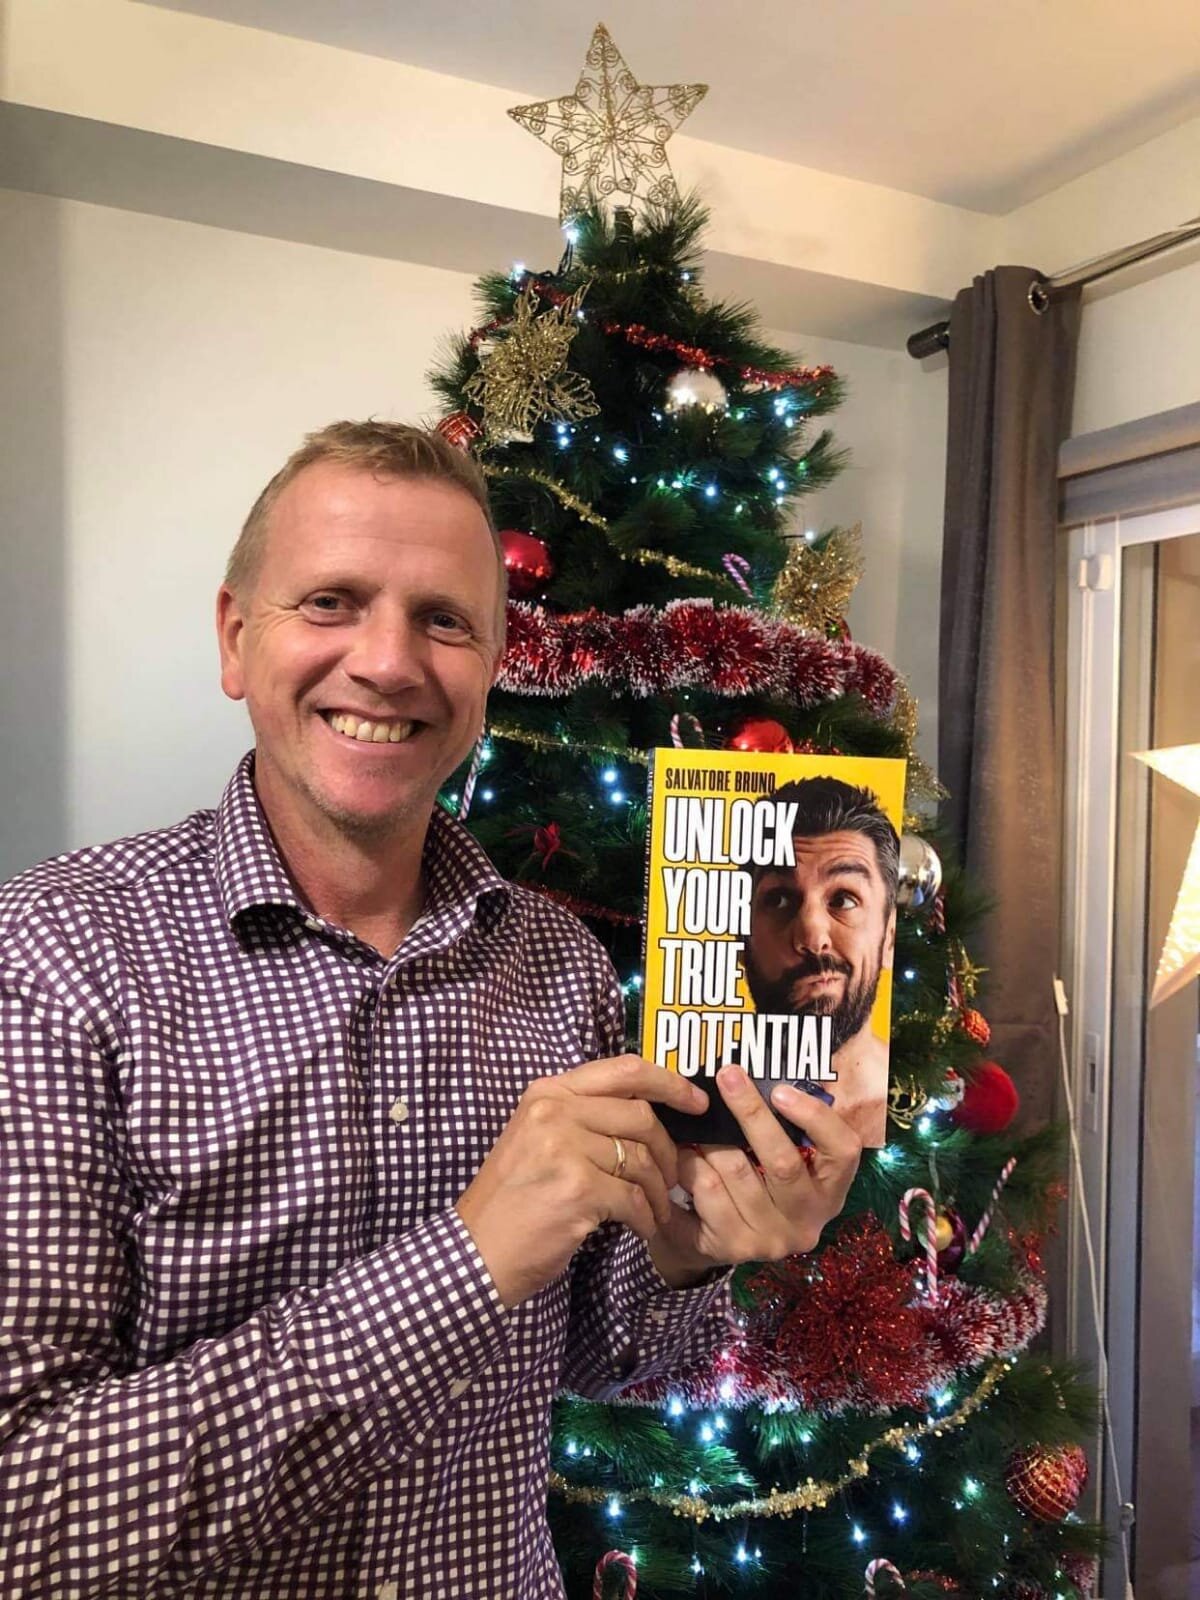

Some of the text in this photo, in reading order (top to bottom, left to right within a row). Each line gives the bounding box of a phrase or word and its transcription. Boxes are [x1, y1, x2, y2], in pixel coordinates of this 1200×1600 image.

[665, 768, 776, 793] SALVATORE BRUNO
[663, 796, 799, 867] UNLOCK
[661, 867, 753, 936] YOUR
[658, 938, 745, 1007] TRUE
[654, 1009, 838, 1081] POTENTIAL
